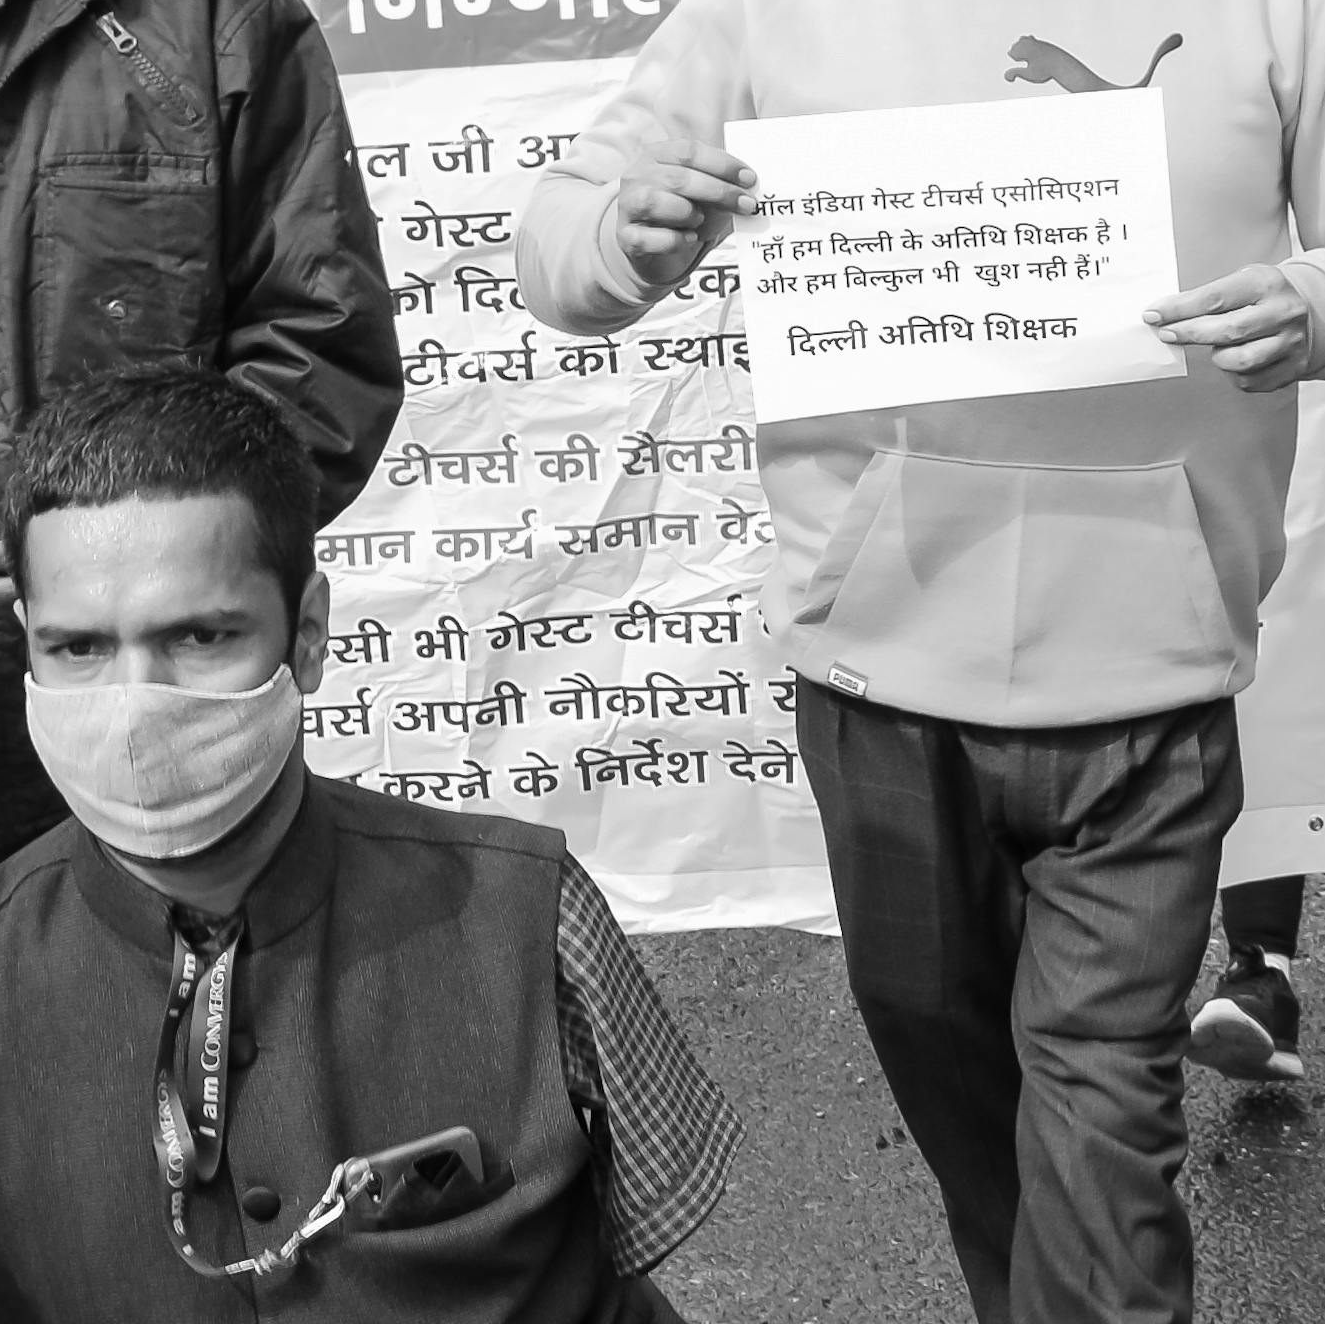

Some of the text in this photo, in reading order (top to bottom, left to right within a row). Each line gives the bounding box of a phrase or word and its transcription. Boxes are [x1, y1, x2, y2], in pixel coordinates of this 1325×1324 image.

[428, 124, 494, 174] जी
[801, 191, 864, 216] इंडिया
[871, 188, 914, 209] गेस्ट
[922, 182, 983, 207] टीचर्स
[991, 177, 1119, 207] एसोसिएशन
[401, 200, 512, 248] गेस्ट
[791, 240, 822, 260] हम
[830, 231, 893, 255] दिल्ली
[900, 229, 923, 250] के
[932, 225, 1007, 249] अतिथि
[1014, 223, 1088, 245] शिक्षक
[1095, 218, 1110, 245] है
[805, 274, 836, 294] हम
[844, 266, 924, 292] बिल्कुल
[932, 261, 959, 282] भी
[974, 264, 1019, 286] खुश
[1027, 256, 1067, 281] नही
[787, 313, 1077, 355] दिल्ली अतिथि शिक्षक
[384, 424, 756, 486] टीचर्स की सैलरी
[316, 530, 415, 565] मान
[555, 513, 699, 555] समान
[329, 618, 391, 663] सी
[414, 615, 469, 661] भी
[486, 611, 593, 651] गेस्ट
[609, 594, 742, 643] टीचर्स
[304, 687, 373, 738] चर्स
[393, 681, 526, 733] अपनी
[544, 670, 751, 720] नौकरियों
[379, 760, 492, 802] करने
[509, 752, 559, 797] के
[575, 738, 708, 791] निर्देश
[723, 739, 798, 783] देने
[202, 1076, 219, 1120] am
